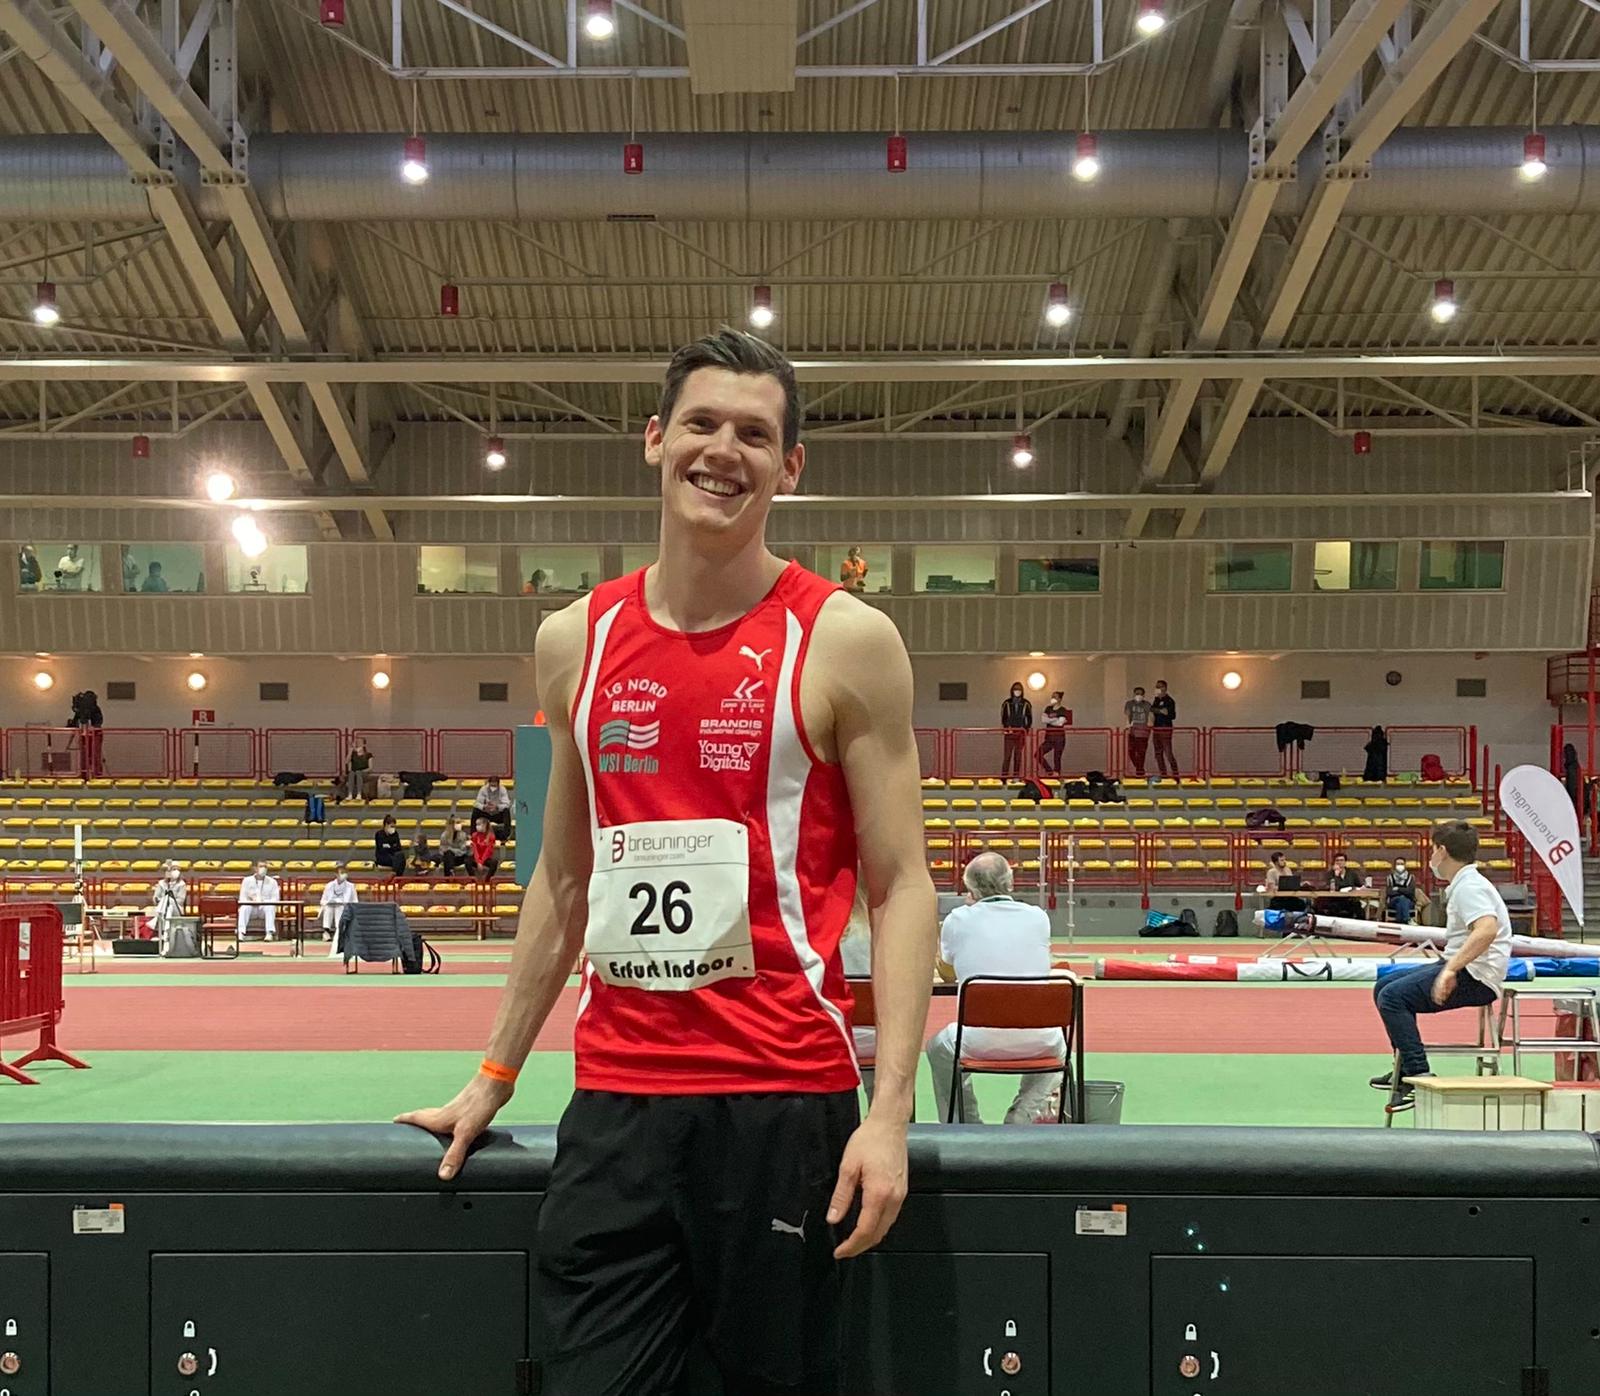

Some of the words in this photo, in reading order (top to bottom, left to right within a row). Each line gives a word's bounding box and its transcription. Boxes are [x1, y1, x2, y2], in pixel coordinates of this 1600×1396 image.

[604, 682, 623, 699] LG
[627, 678, 668, 698] NORD
[611, 700, 657, 713] BERLIN
[700, 719, 763, 729] BRANDIS
[698, 739, 742, 759] Young
[598, 753, 620, 773] WSI
[623, 754, 659, 775] Berlin
[699, 754, 751, 772] Digitals
[628, 834, 714, 853] breuninger
[628, 880, 694, 936] 26
[609, 959, 661, 979] Erfurt
[664, 956, 735, 979] Indoor
